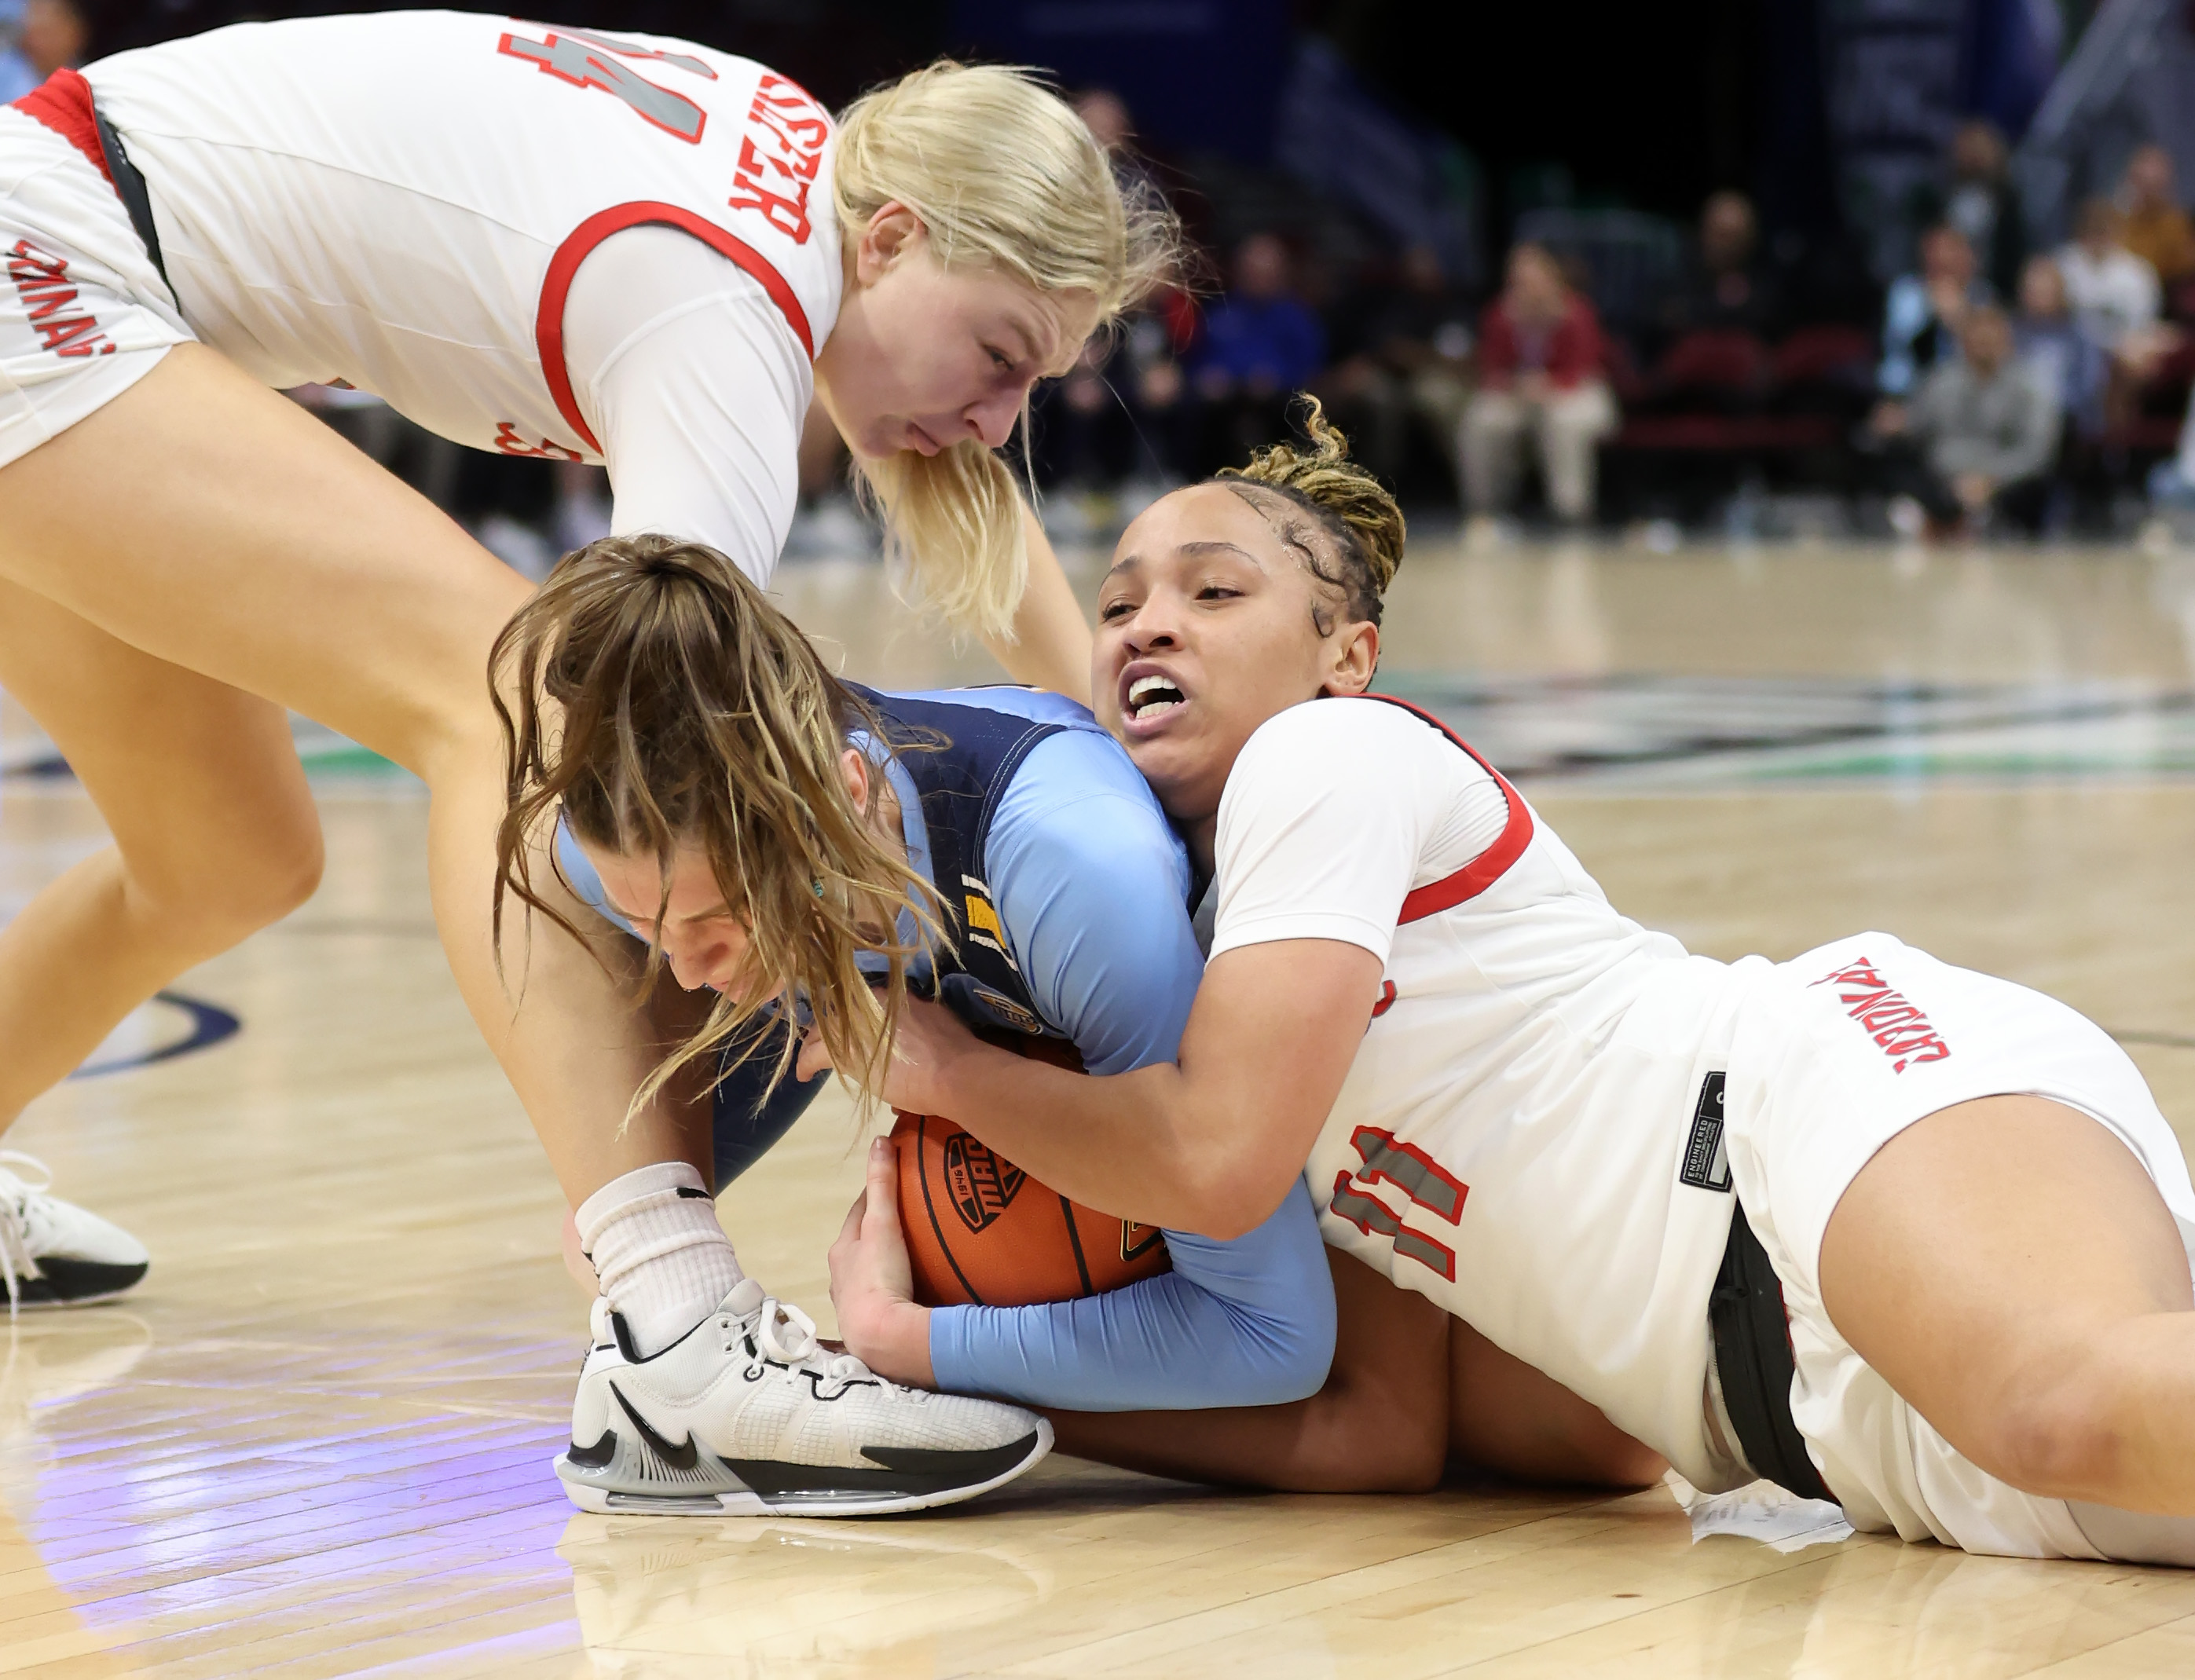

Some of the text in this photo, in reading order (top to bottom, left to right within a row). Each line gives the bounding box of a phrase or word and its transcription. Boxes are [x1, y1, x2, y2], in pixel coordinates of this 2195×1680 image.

[954, 1169, 969, 1195] 1946
[964, 1138, 1006, 1216] MAC
[1687, 1120, 1708, 1177] ENGINEERED
[1330, 1125, 1469, 1283] 11
